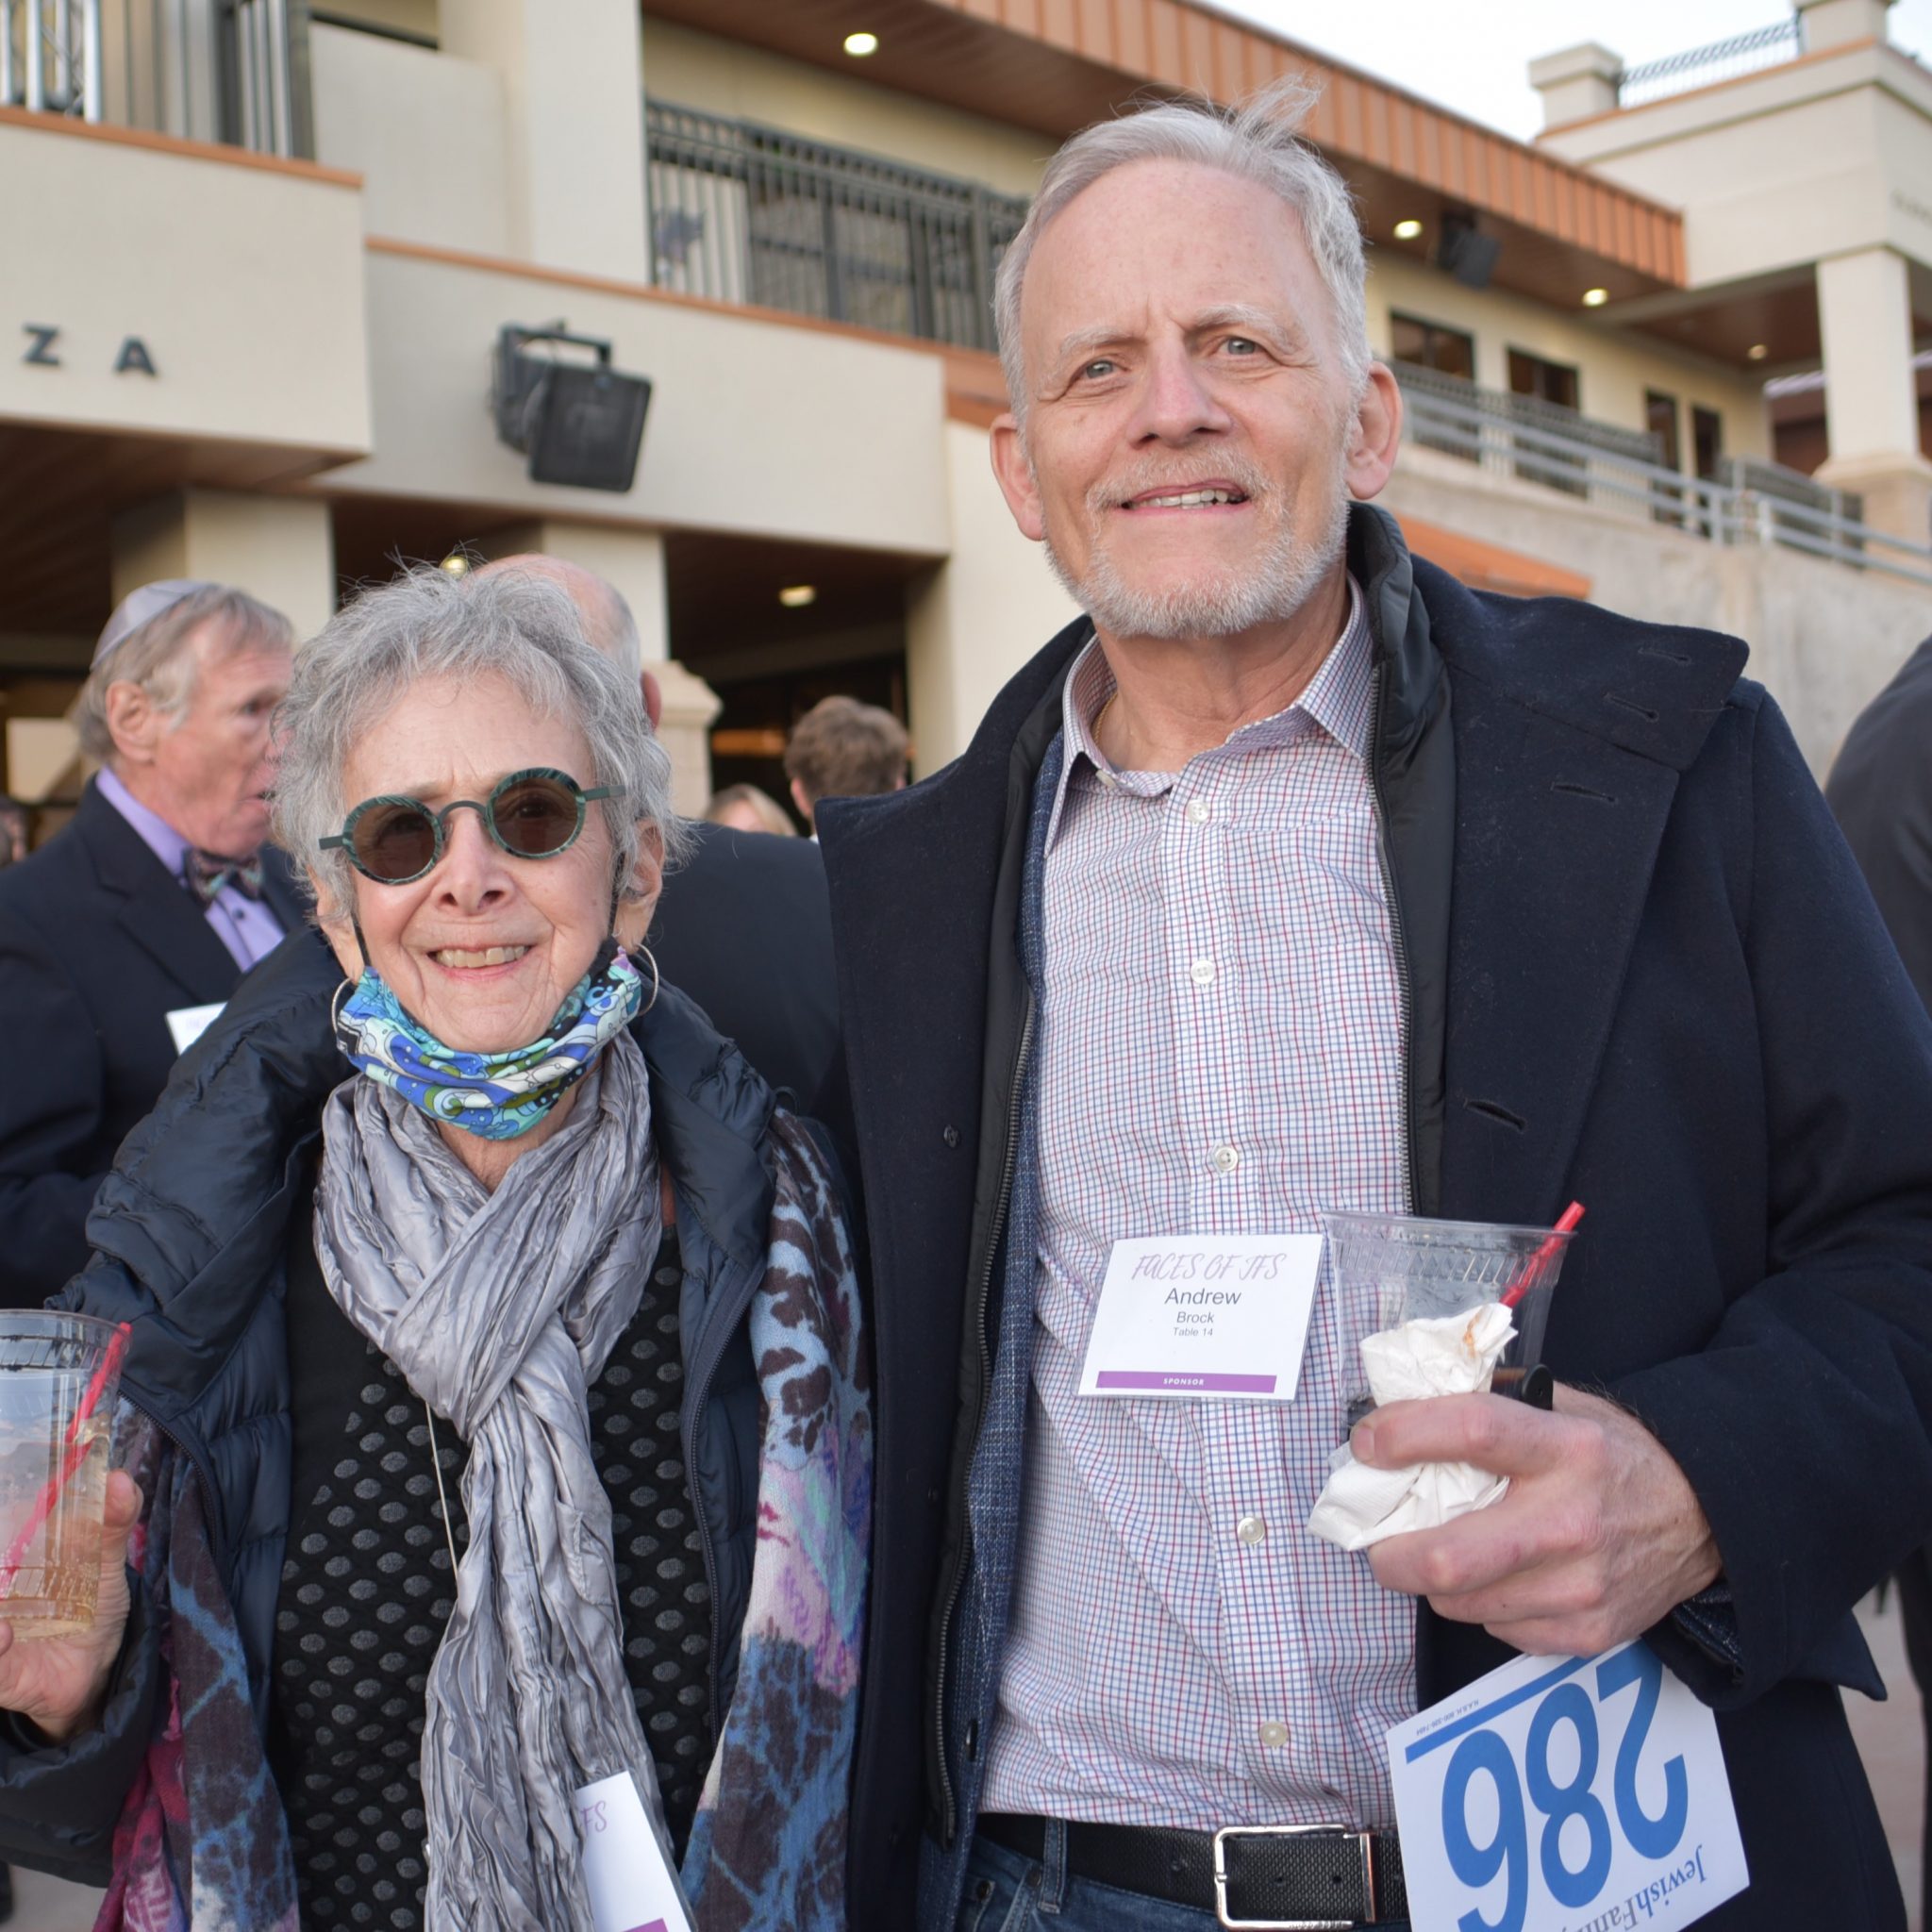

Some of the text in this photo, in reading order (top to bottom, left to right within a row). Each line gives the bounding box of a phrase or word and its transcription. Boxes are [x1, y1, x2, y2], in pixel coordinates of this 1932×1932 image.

[1131, 1253, 1288, 1281] FACES OF JFS
[1164, 1288, 1242, 1306] Andrew
[1176, 1311, 1215, 1324] Brock
[1173, 1327, 1214, 1337] Table 14
[1163, 1377, 1205, 1387] SPONSOR
[1441, 1639, 1689, 1932] 286
[580, 1800, 608, 1837] FS
